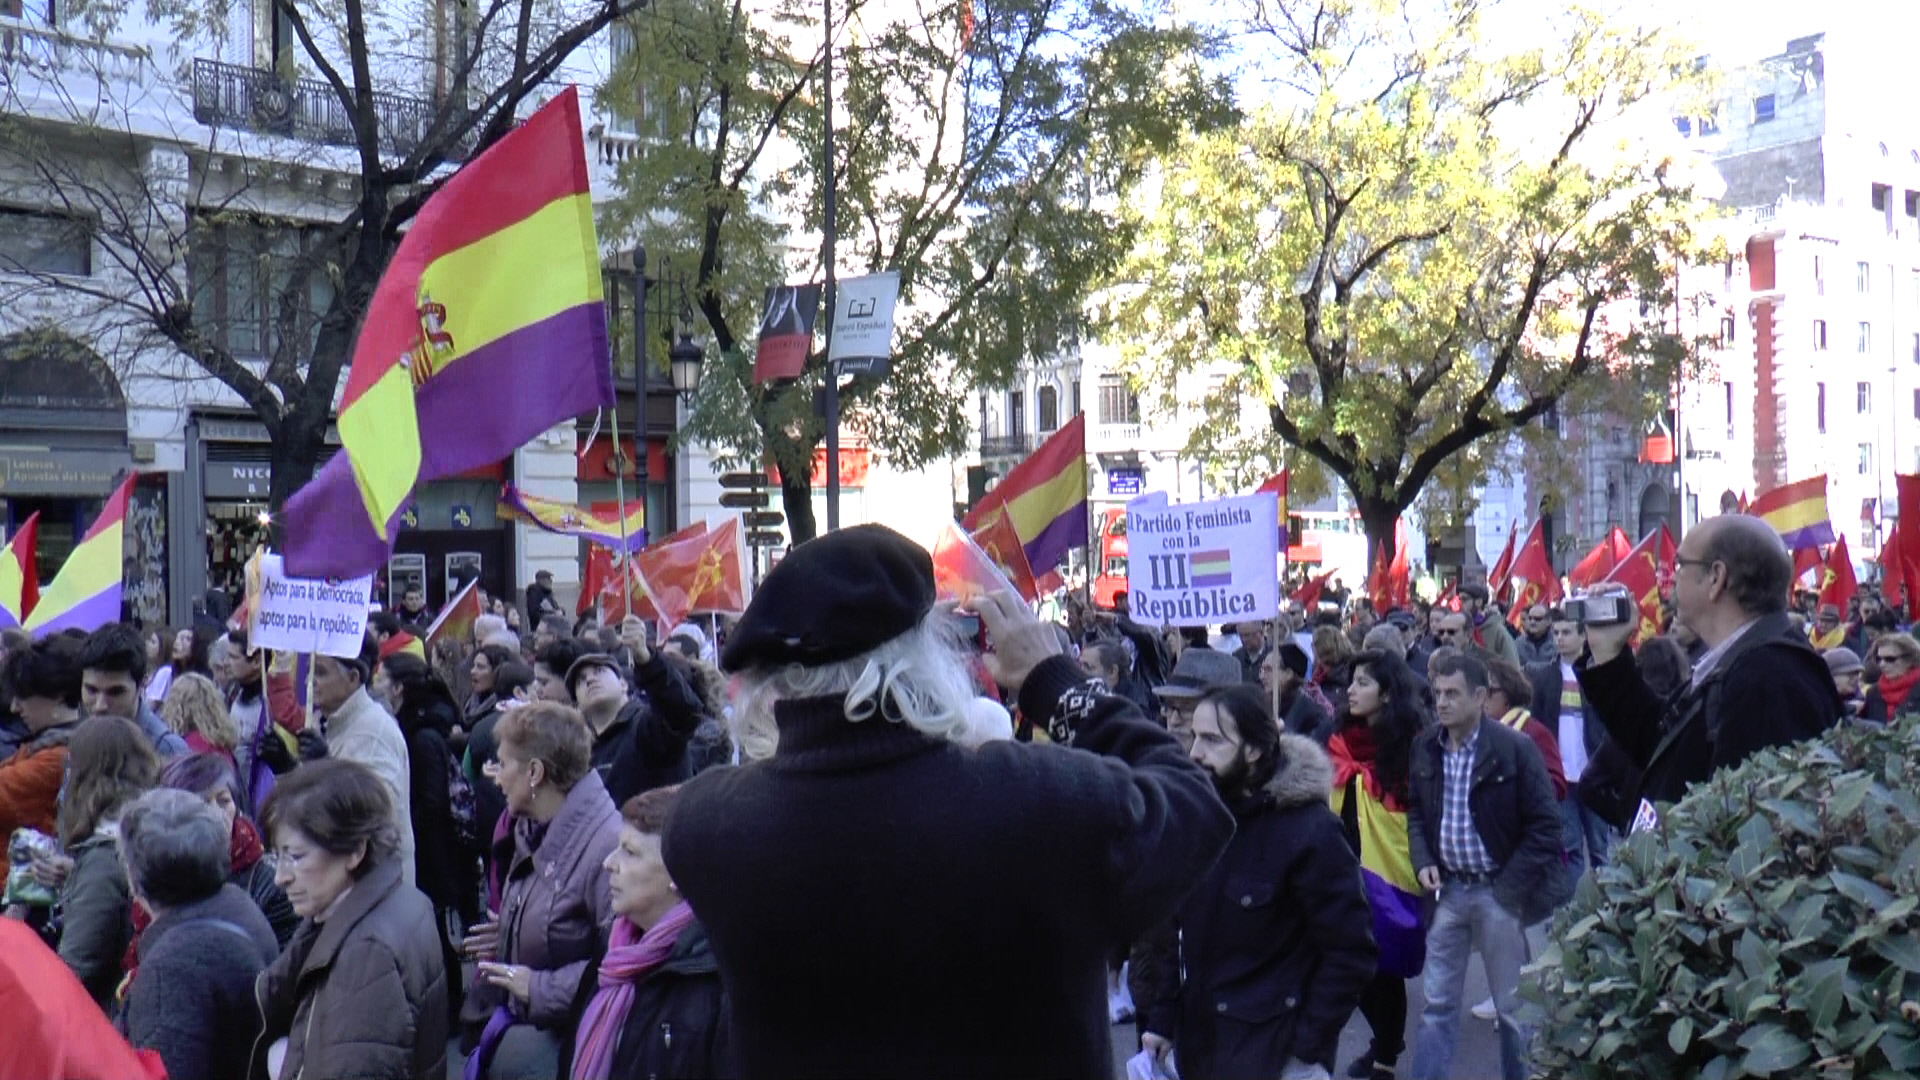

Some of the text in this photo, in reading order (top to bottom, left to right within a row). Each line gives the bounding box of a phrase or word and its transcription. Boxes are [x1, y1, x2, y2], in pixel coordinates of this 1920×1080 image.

[62, 471, 78, 481] del
[1135, 513, 1181, 533] Partido
[1185, 506, 1252, 531] Feminista
[1162, 531, 1200, 549] con la
[1148, 553, 1188, 591] III
[264, 576, 288, 600] Aptos
[289, 582, 306, 600] para
[308, 578, 315, 600] la
[1135, 587, 1256, 625] República
[259, 610, 360, 638] aptos para la república
